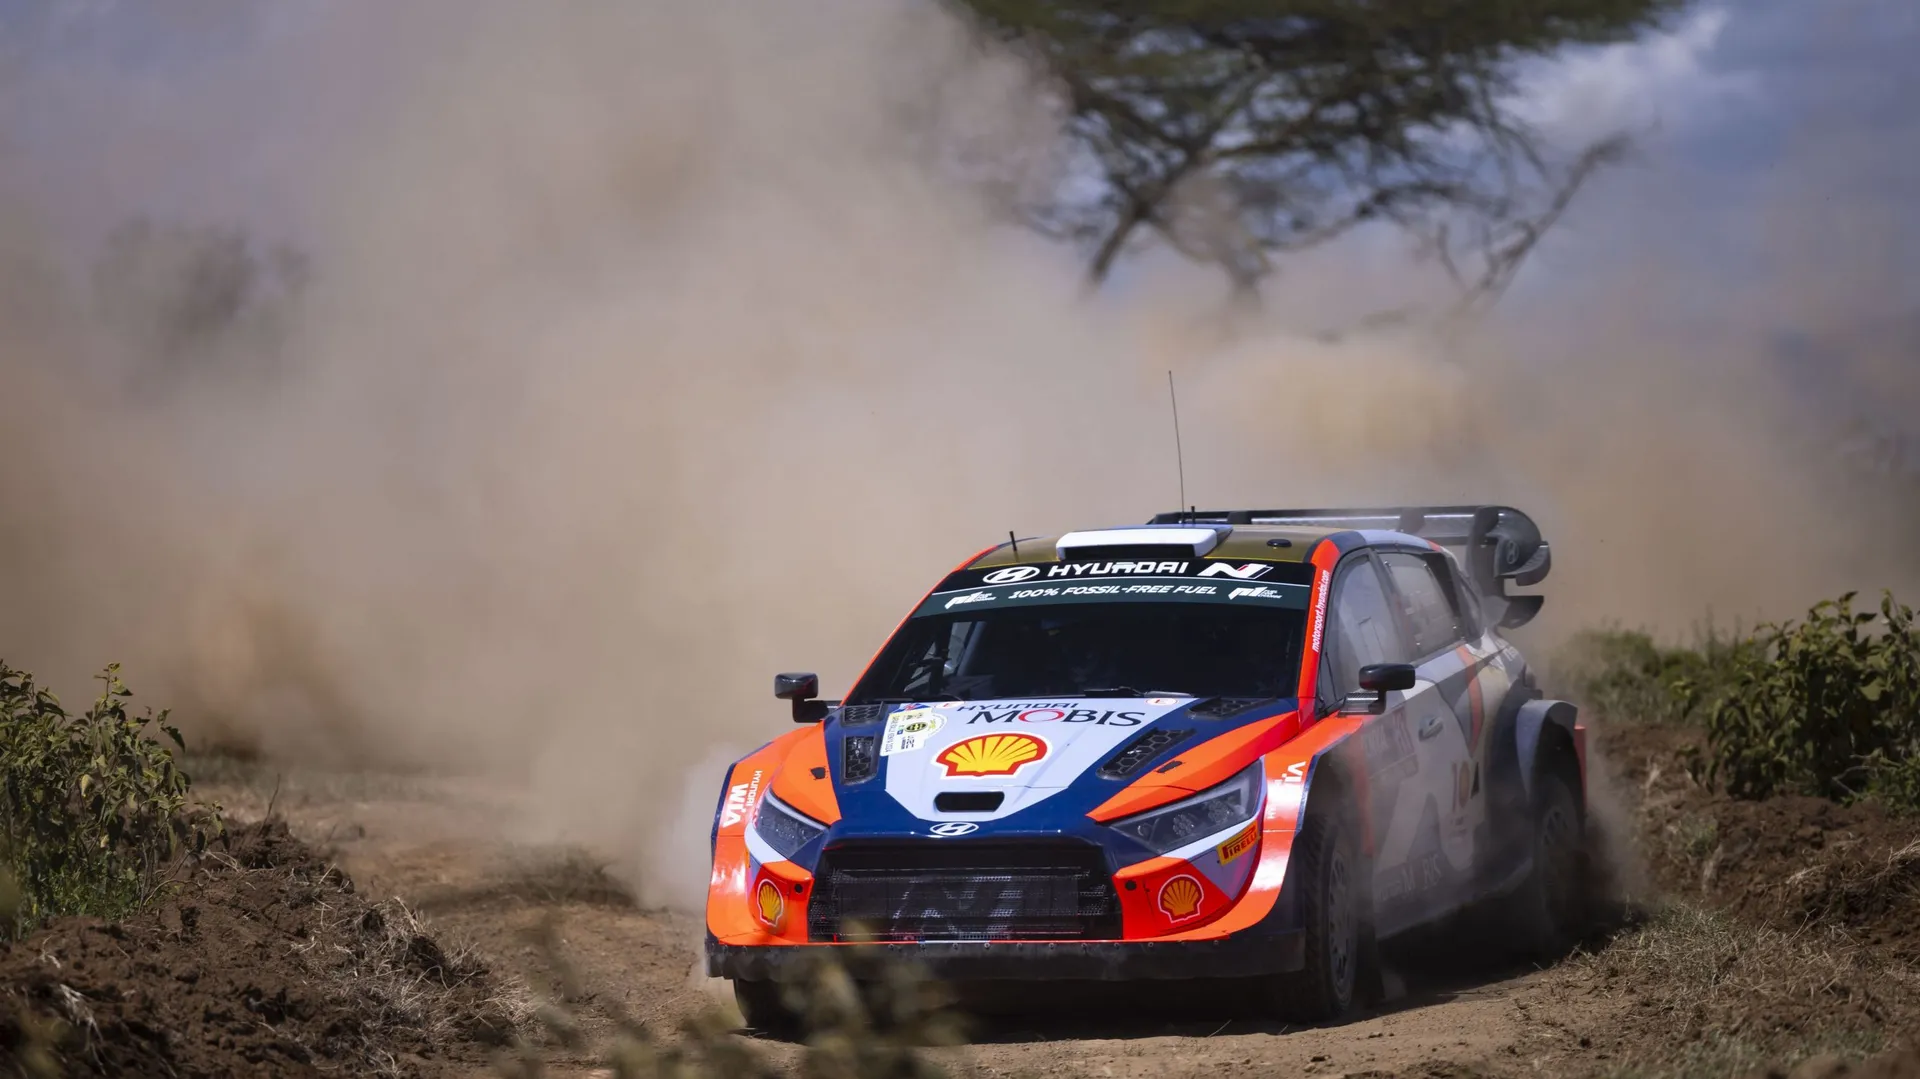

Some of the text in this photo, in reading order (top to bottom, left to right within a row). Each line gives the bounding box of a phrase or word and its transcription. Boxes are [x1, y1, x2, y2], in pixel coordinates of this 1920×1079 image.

[1047, 562, 1189, 577] HYUNDAI
[1197, 562, 1274, 579] N
[1008, 588, 1060, 599] 100%
[1061, 585, 1175, 596] FOSSIL-FREE
[1173, 586, 1218, 595] FUEL
[1312, 570, 1330, 653] motorsport.hyundai.com
[957, 702, 1080, 712] HYUNDAI
[966, 708, 1146, 727] MOBIS
[746, 770, 763, 806] HYUNDAI
[1221, 825, 1257, 859] PIRELLI
